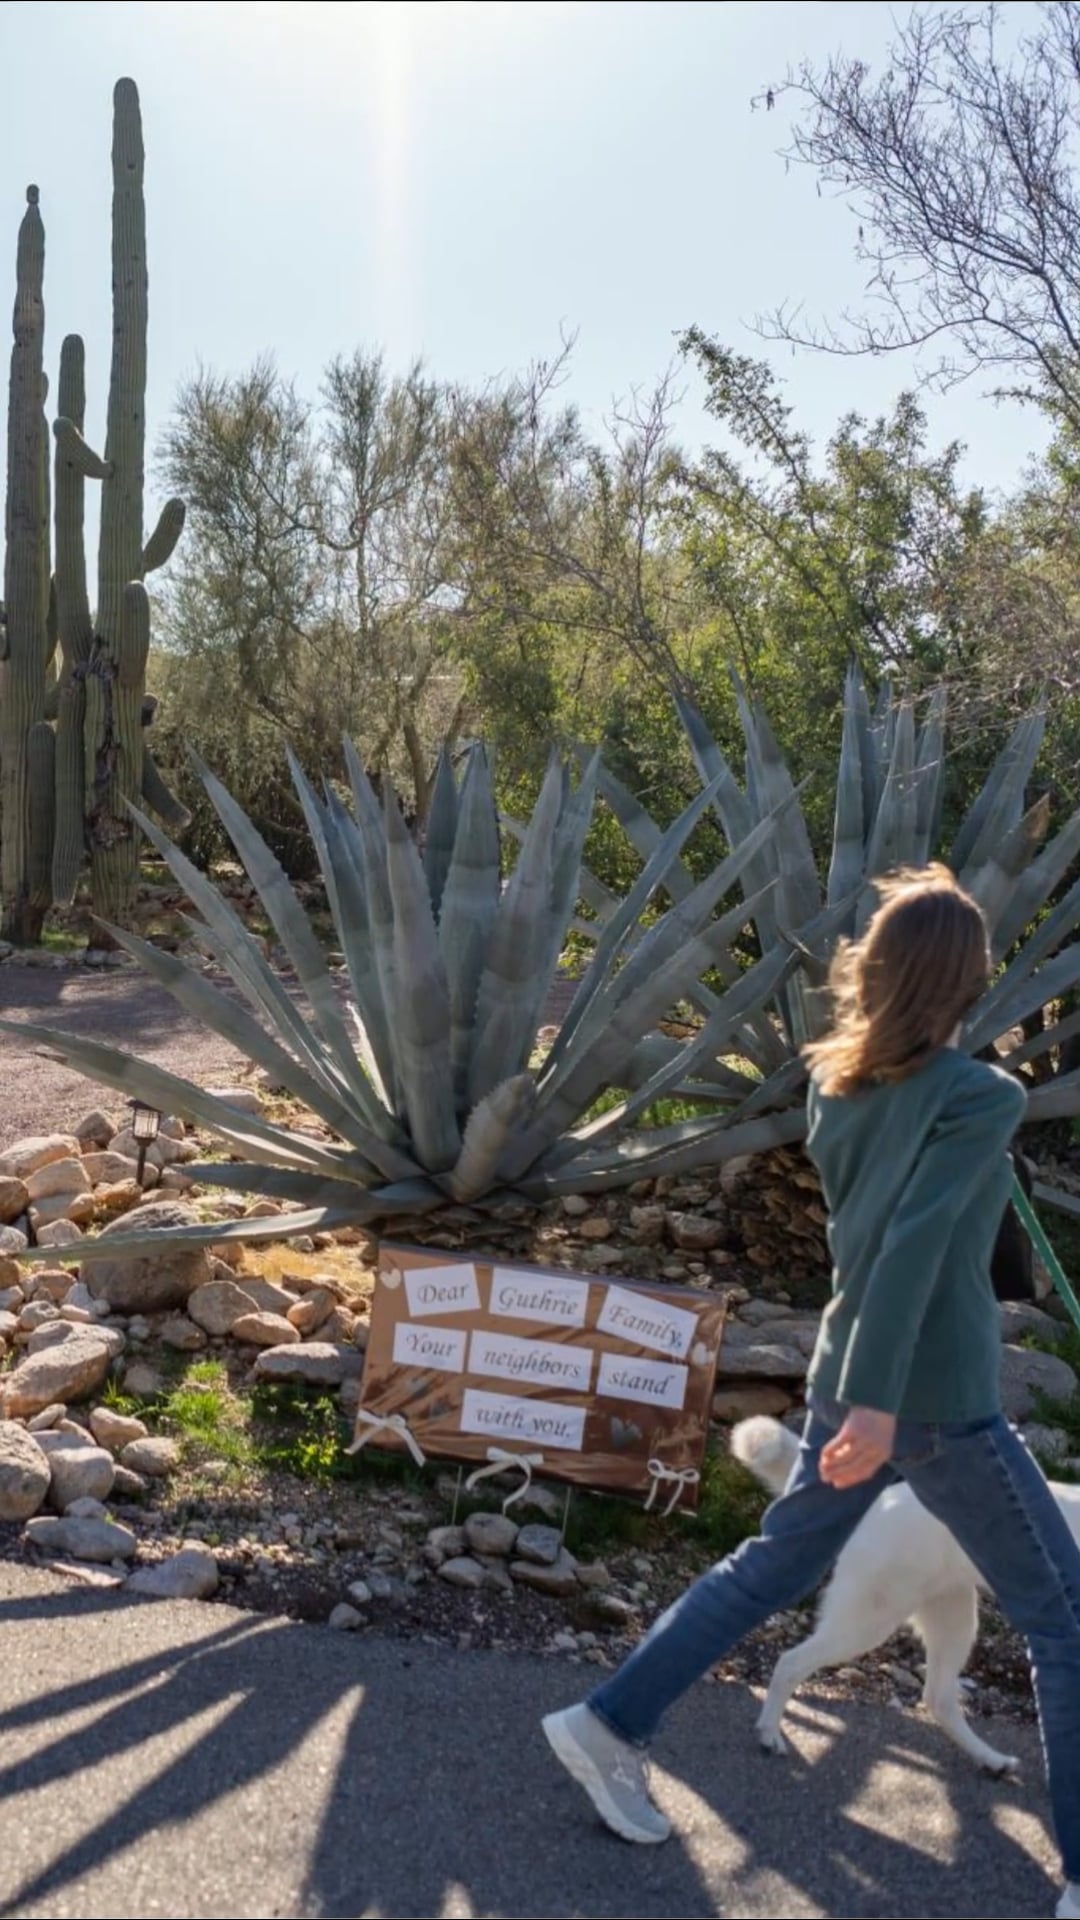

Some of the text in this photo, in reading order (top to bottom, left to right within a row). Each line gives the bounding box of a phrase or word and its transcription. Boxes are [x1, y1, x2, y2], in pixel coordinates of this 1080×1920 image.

[417, 1283, 471, 1305] Dear
[499, 1286, 579, 1316] Guthrie
[405, 1332, 677, 1396] Your neighbors stand
[475, 1404, 572, 1439] with you.
